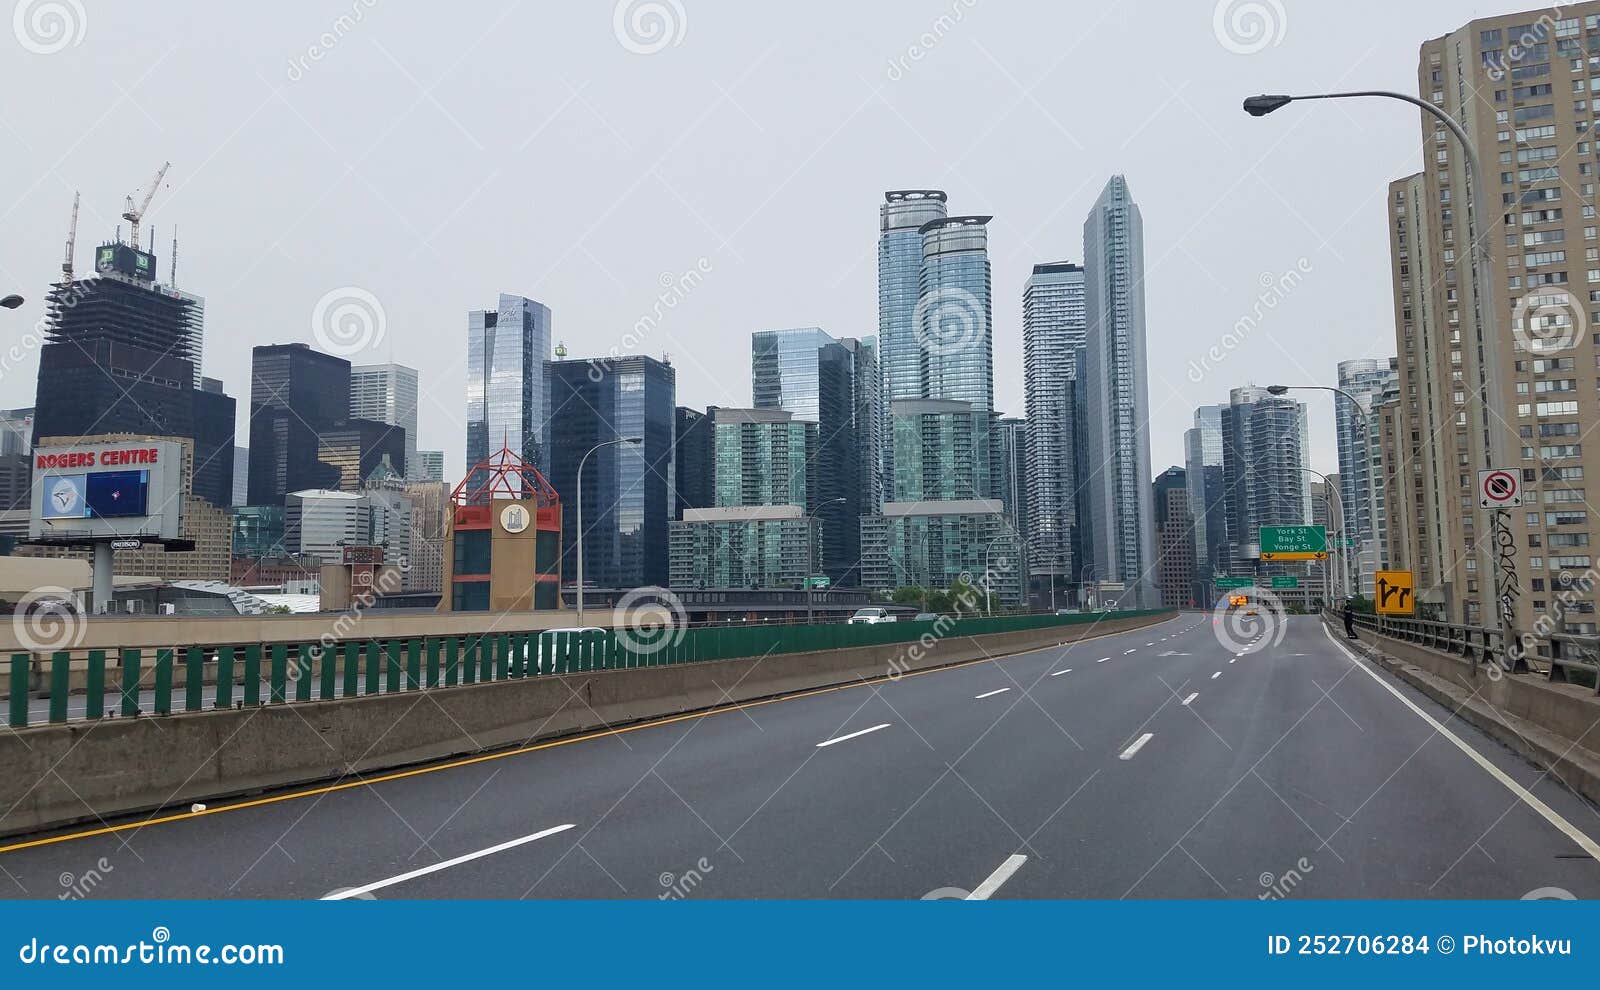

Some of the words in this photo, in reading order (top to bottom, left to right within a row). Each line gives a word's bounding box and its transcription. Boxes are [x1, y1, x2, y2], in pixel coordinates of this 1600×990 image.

[37, 452, 96, 469] ROGERS
[100, 448, 159, 466] CENTRE
[1274, 544, 1300, 552] Yonge
